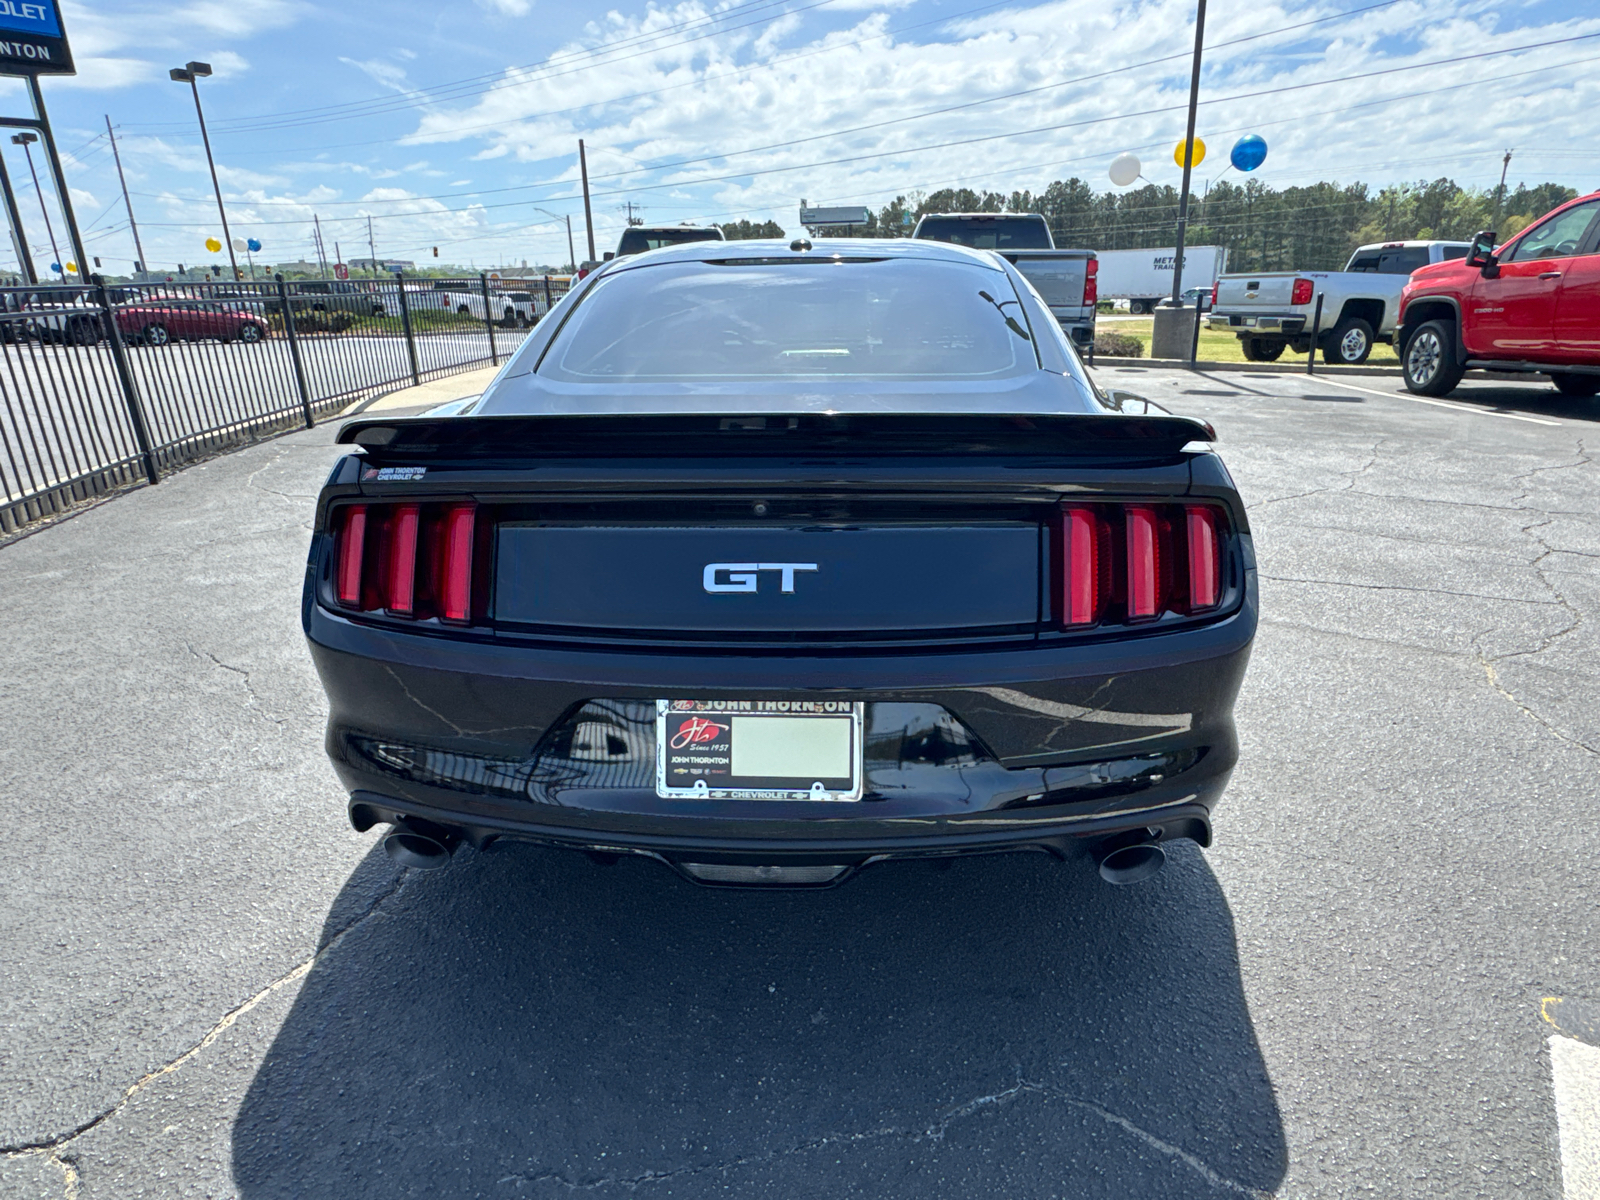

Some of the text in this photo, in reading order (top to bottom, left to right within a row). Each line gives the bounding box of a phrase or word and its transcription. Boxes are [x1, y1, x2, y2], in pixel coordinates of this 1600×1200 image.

[703, 563, 819, 594] GT
[703, 700, 851, 712] JOHN THORNON
[689, 743, 730, 752] Since 1957
[671, 756, 730, 765] JOHN THORNTON
[731, 791, 789, 799] CHEVROLET
